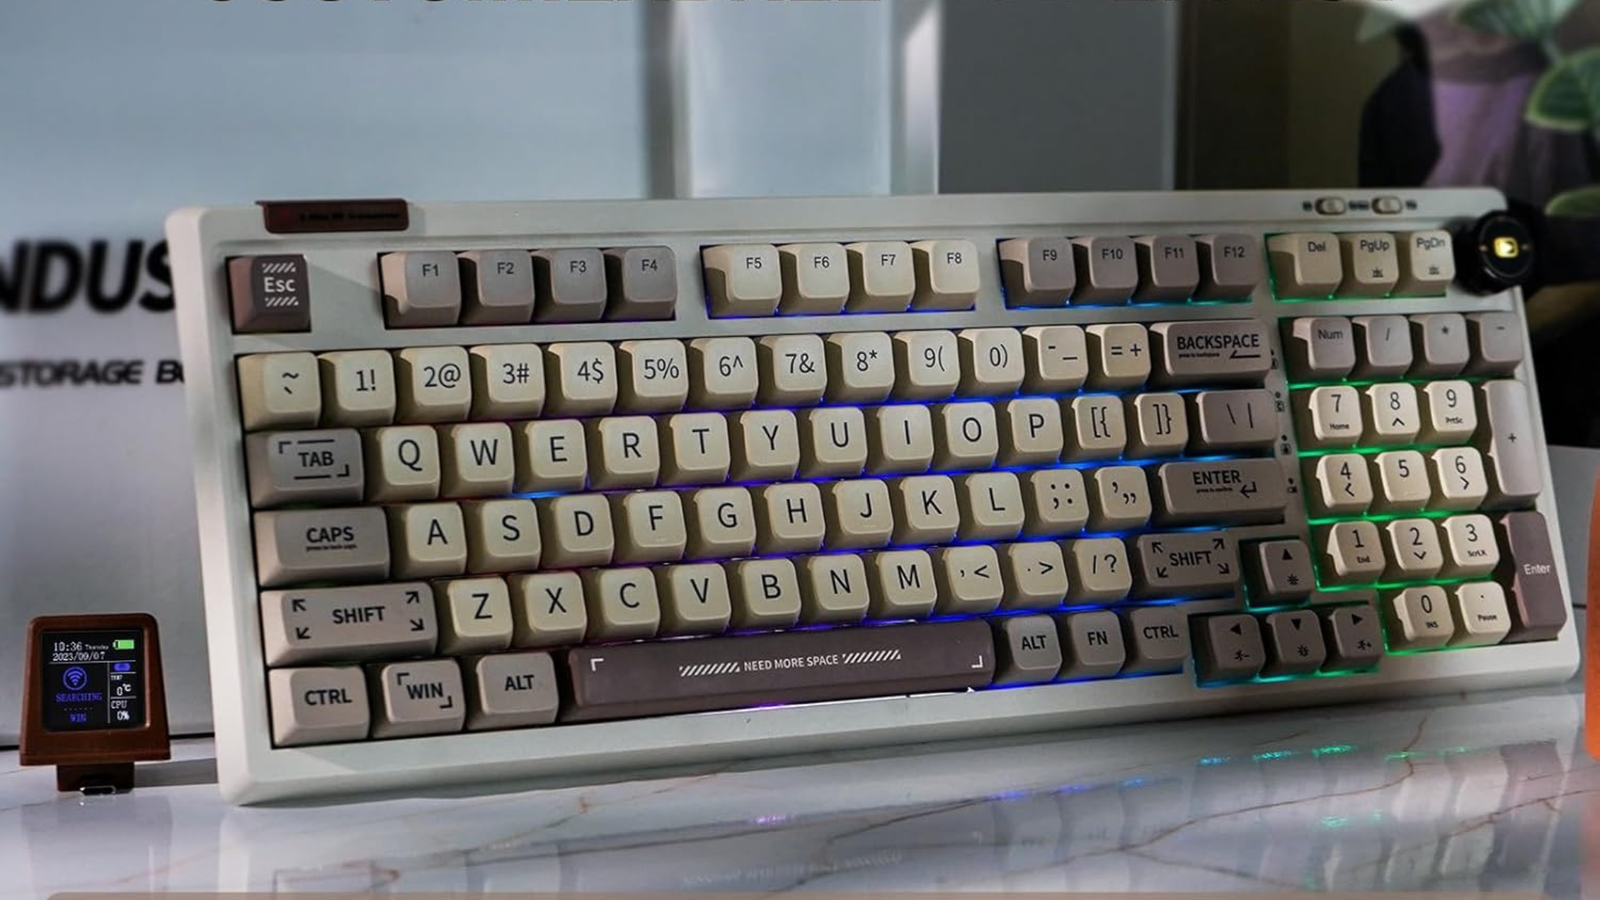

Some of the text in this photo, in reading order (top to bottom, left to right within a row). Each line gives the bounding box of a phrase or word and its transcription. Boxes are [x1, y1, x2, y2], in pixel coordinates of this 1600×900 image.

[1224, 246, 1245, 258] F12
[1308, 241, 1326, 252] Del
[1360, 239, 1390, 253] PgUp
[1416, 236, 1446, 250] PgDn
[814, 256, 830, 268] F6
[881, 254, 896, 266] F7
[947, 252, 963, 264] F8
[1043, 250, 1058, 261] F9
[1102, 248, 1123, 260] F10
[1164, 247, 1185, 259] F11
[422, 264, 439, 276] F1
[497, 262, 514, 275] F2
[570, 260, 587, 273] F3
[641, 258, 658, 271] F4
[746, 257, 762, 269] F5
[264, 277, 296, 292] Esc
[1176, 333, 1260, 350] BACKSPACE
[1318, 329, 1343, 340] Num
[785, 353, 815, 374] 7&
[924, 345, 945, 371] 9(
[989, 343, 1008, 368] 0)
[155, 359, 185, 384] B
[424, 363, 461, 388] 2@
[502, 363, 530, 384] 3#
[577, 358, 605, 384] 4$
[644, 358, 679, 379] 5%
[718, 355, 744, 377] 6^
[356, 370, 376, 391] 1!
[1331, 394, 1342, 413] 7
[1389, 391, 1401, 411] 8
[1446, 389, 1458, 408] 9
[830, 421, 849, 448] U
[903, 419, 912, 445] I
[962, 416, 982, 443] O
[1027, 412, 1046, 439] P
[1329, 422, 1350, 431] Home
[621, 432, 642, 459] R
[692, 428, 710, 455] T
[761, 424, 779, 451] Y
[298, 450, 334, 467] TAB
[397, 439, 423, 472] Q
[470, 438, 499, 466] W
[549, 435, 568, 463] E
[1340, 462, 1351, 480] 4
[1398, 459, 1410, 478] 5
[1455, 455, 1467, 475] 6
[1192, 469, 1242, 486] ENTER
[860, 491, 873, 519] J
[920, 489, 943, 516] K
[988, 487, 1006, 512] L
[647, 504, 664, 532] F
[716, 502, 738, 529] G
[785, 497, 808, 524] H
[426, 519, 449, 546] A
[501, 515, 521, 542] S
[574, 510, 595, 537] D
[1466, 524, 1478, 542] 3
[306, 526, 355, 543] CAPS
[1352, 529, 1365, 549] 1
[1410, 527, 1423, 546] 2
[1169, 551, 1213, 567] SHIFT
[1357, 556, 1371, 564] End
[896, 564, 921, 591] M
[1523, 564, 1552, 576] Enter
[690, 577, 710, 604] V
[761, 573, 782, 600] B
[830, 569, 852, 595] N
[545, 586, 568, 615] X
[619, 582, 641, 609] C
[1420, 595, 1433, 614] 0
[332, 606, 386, 624] SHIFT
[471, 593, 493, 620] Z
[1087, 631, 1108, 646] FN
[1142, 624, 1179, 640] CTRL
[53, 641, 83, 652] 10:36
[1021, 635, 1047, 650] ALT
[52, 651, 106, 662] 2023/09/07
[743, 653, 840, 672] NEED MORE SPACE
[407, 682, 443, 700] WIN
[504, 674, 535, 692] ALT
[55, 692, 103, 703] SEARCHING
[110, 700, 128, 709] CPU
[304, 688, 352, 706] CTRL
[117, 710, 130, 721] 0%
